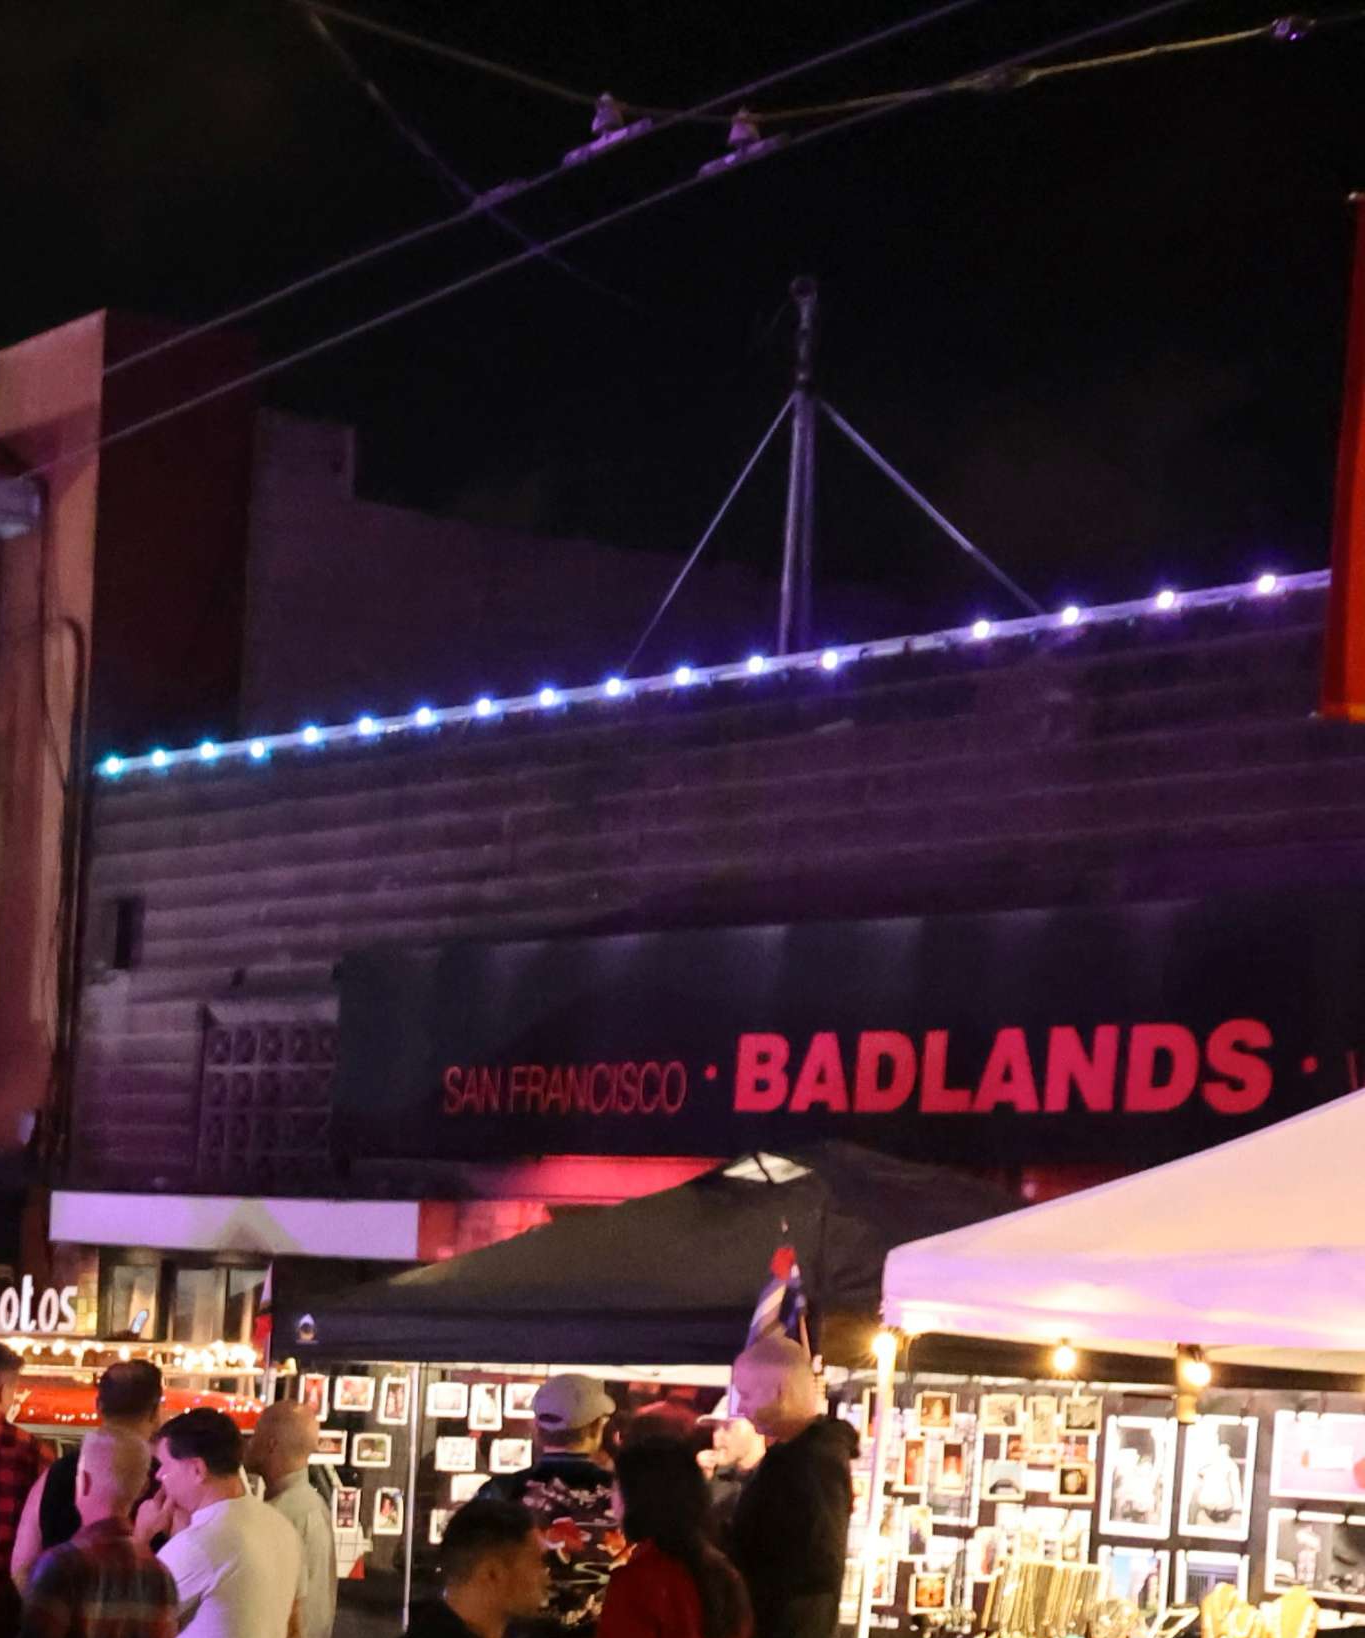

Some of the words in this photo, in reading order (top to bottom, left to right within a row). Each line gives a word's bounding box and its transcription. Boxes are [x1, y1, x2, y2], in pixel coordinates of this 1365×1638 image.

[443, 1065, 500, 1115] SAN
[508, 1059, 688, 1115] FRANCISCO
[731, 1016, 1275, 1115] BADLANDS
